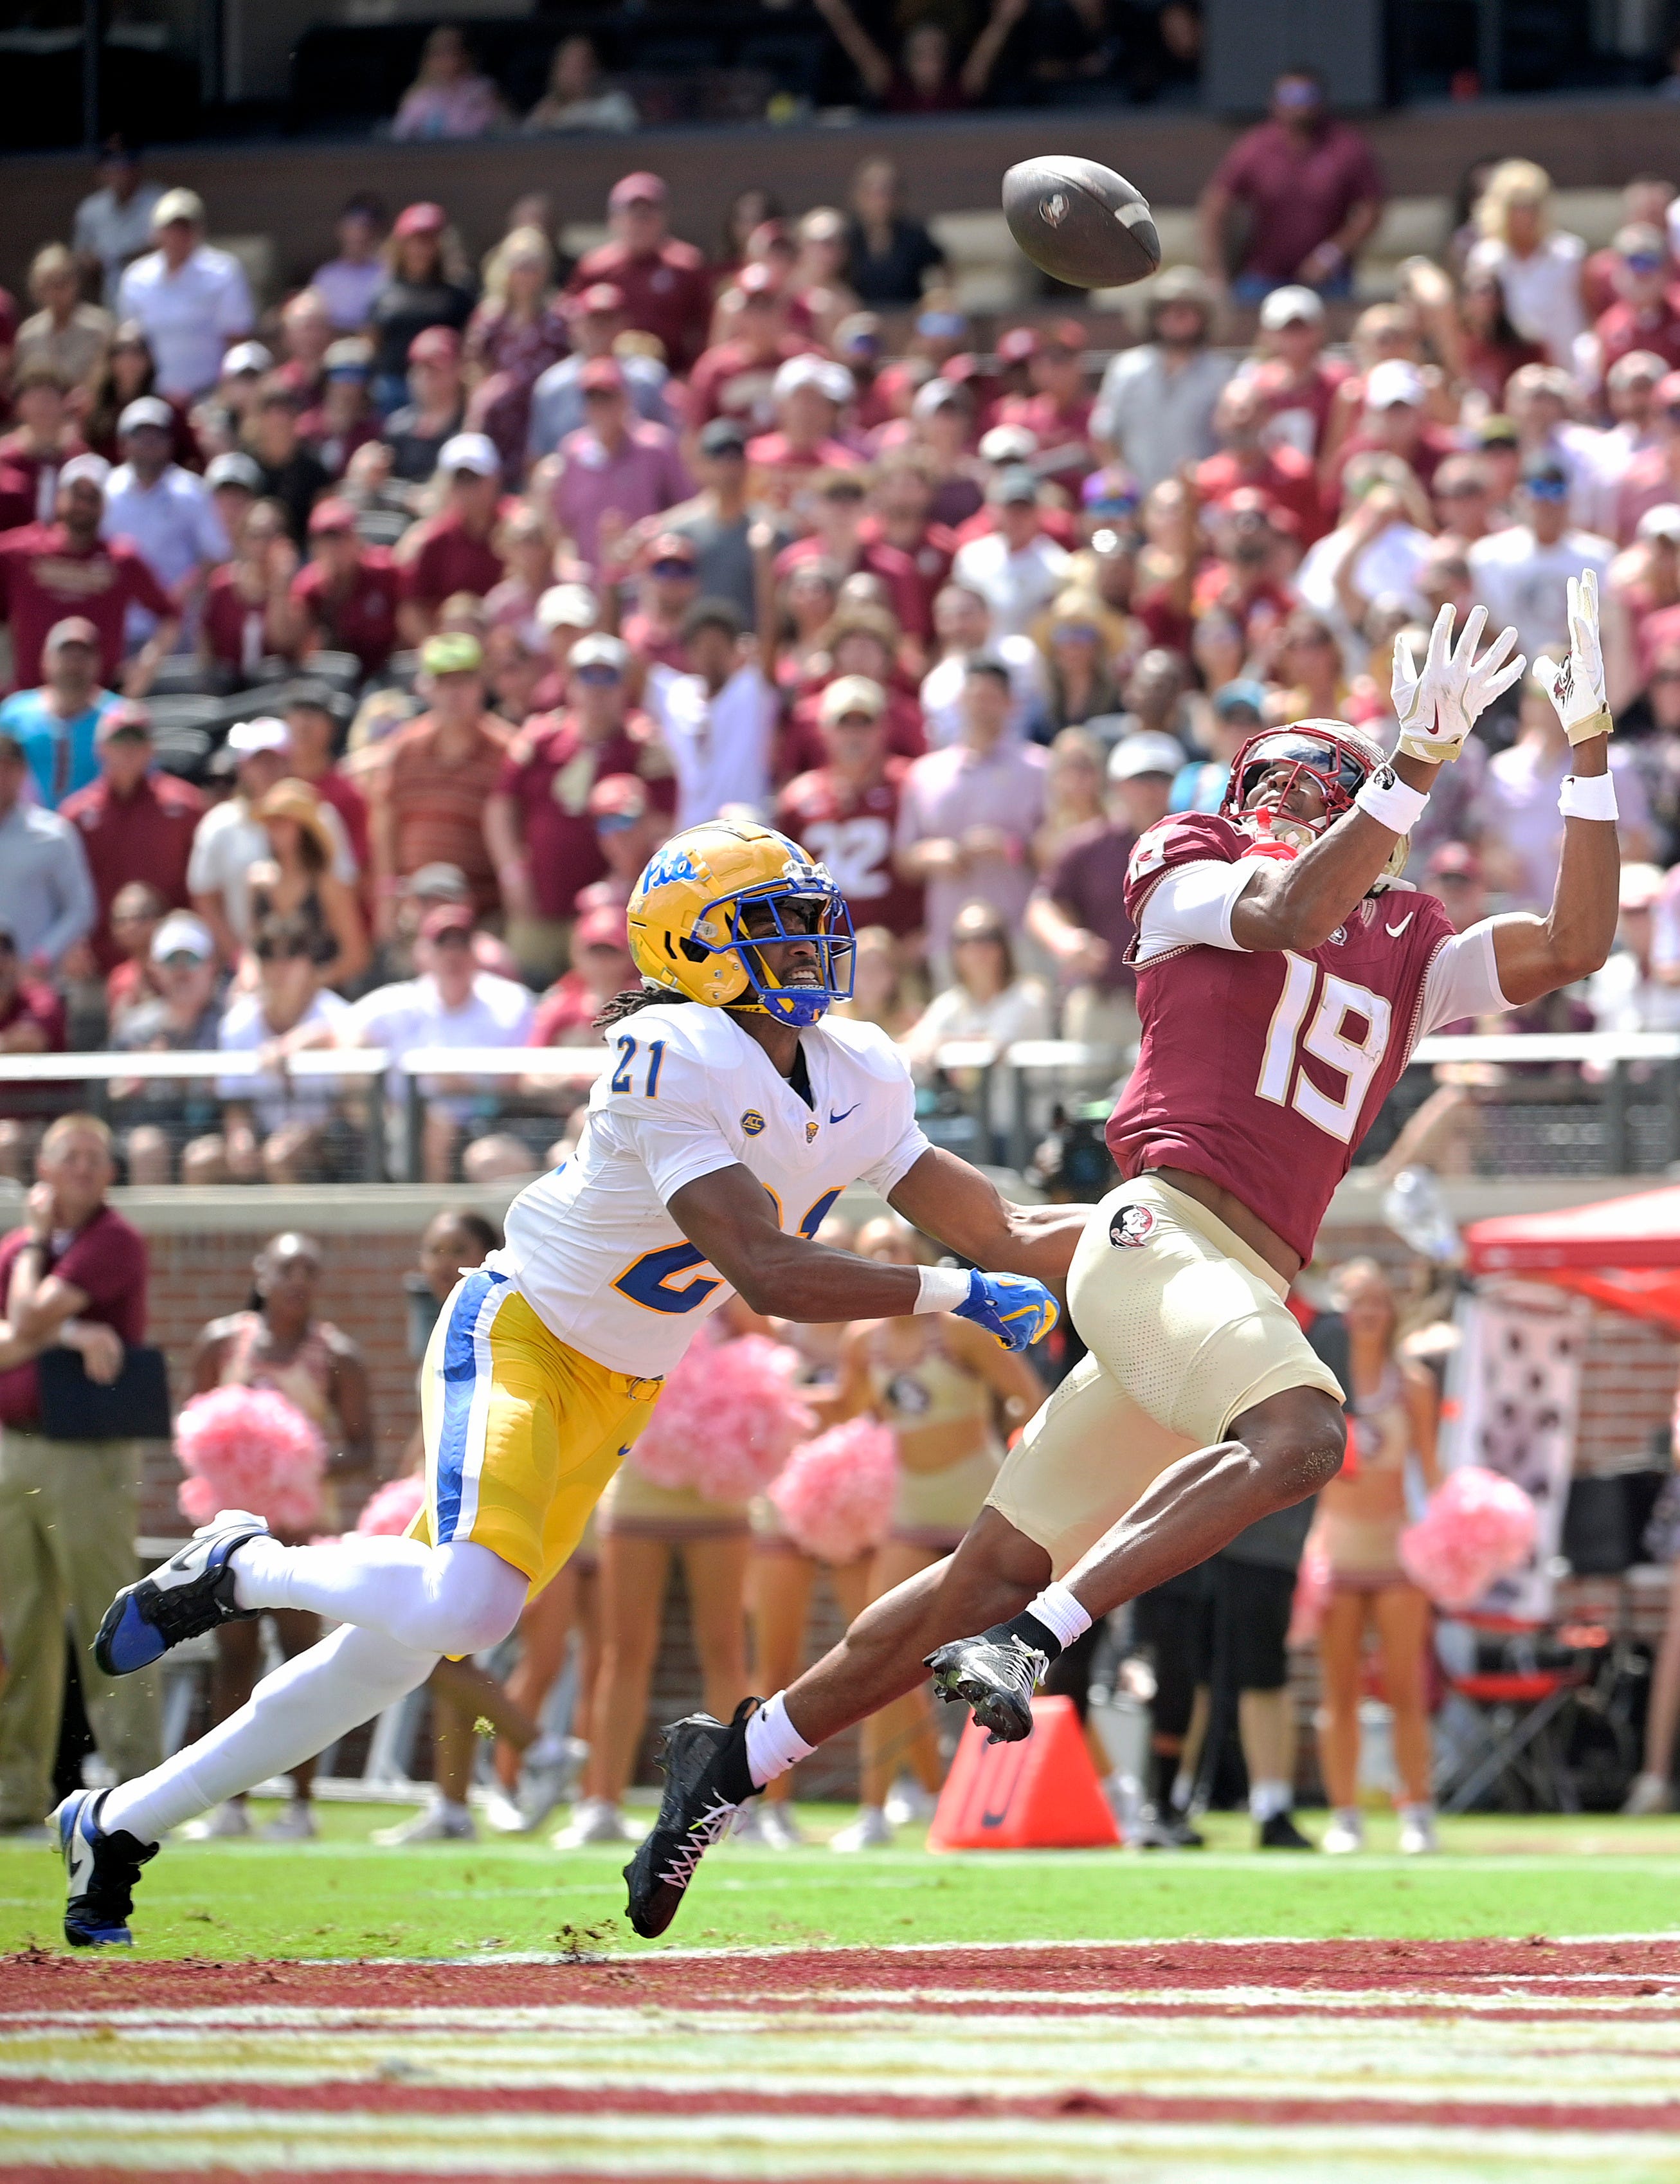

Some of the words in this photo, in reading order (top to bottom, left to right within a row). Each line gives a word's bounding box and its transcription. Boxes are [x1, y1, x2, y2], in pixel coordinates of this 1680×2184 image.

[611, 1033, 669, 1100] 21
[1255, 950, 1392, 1144] 19
[743, 1115, 764, 1128] ACC
